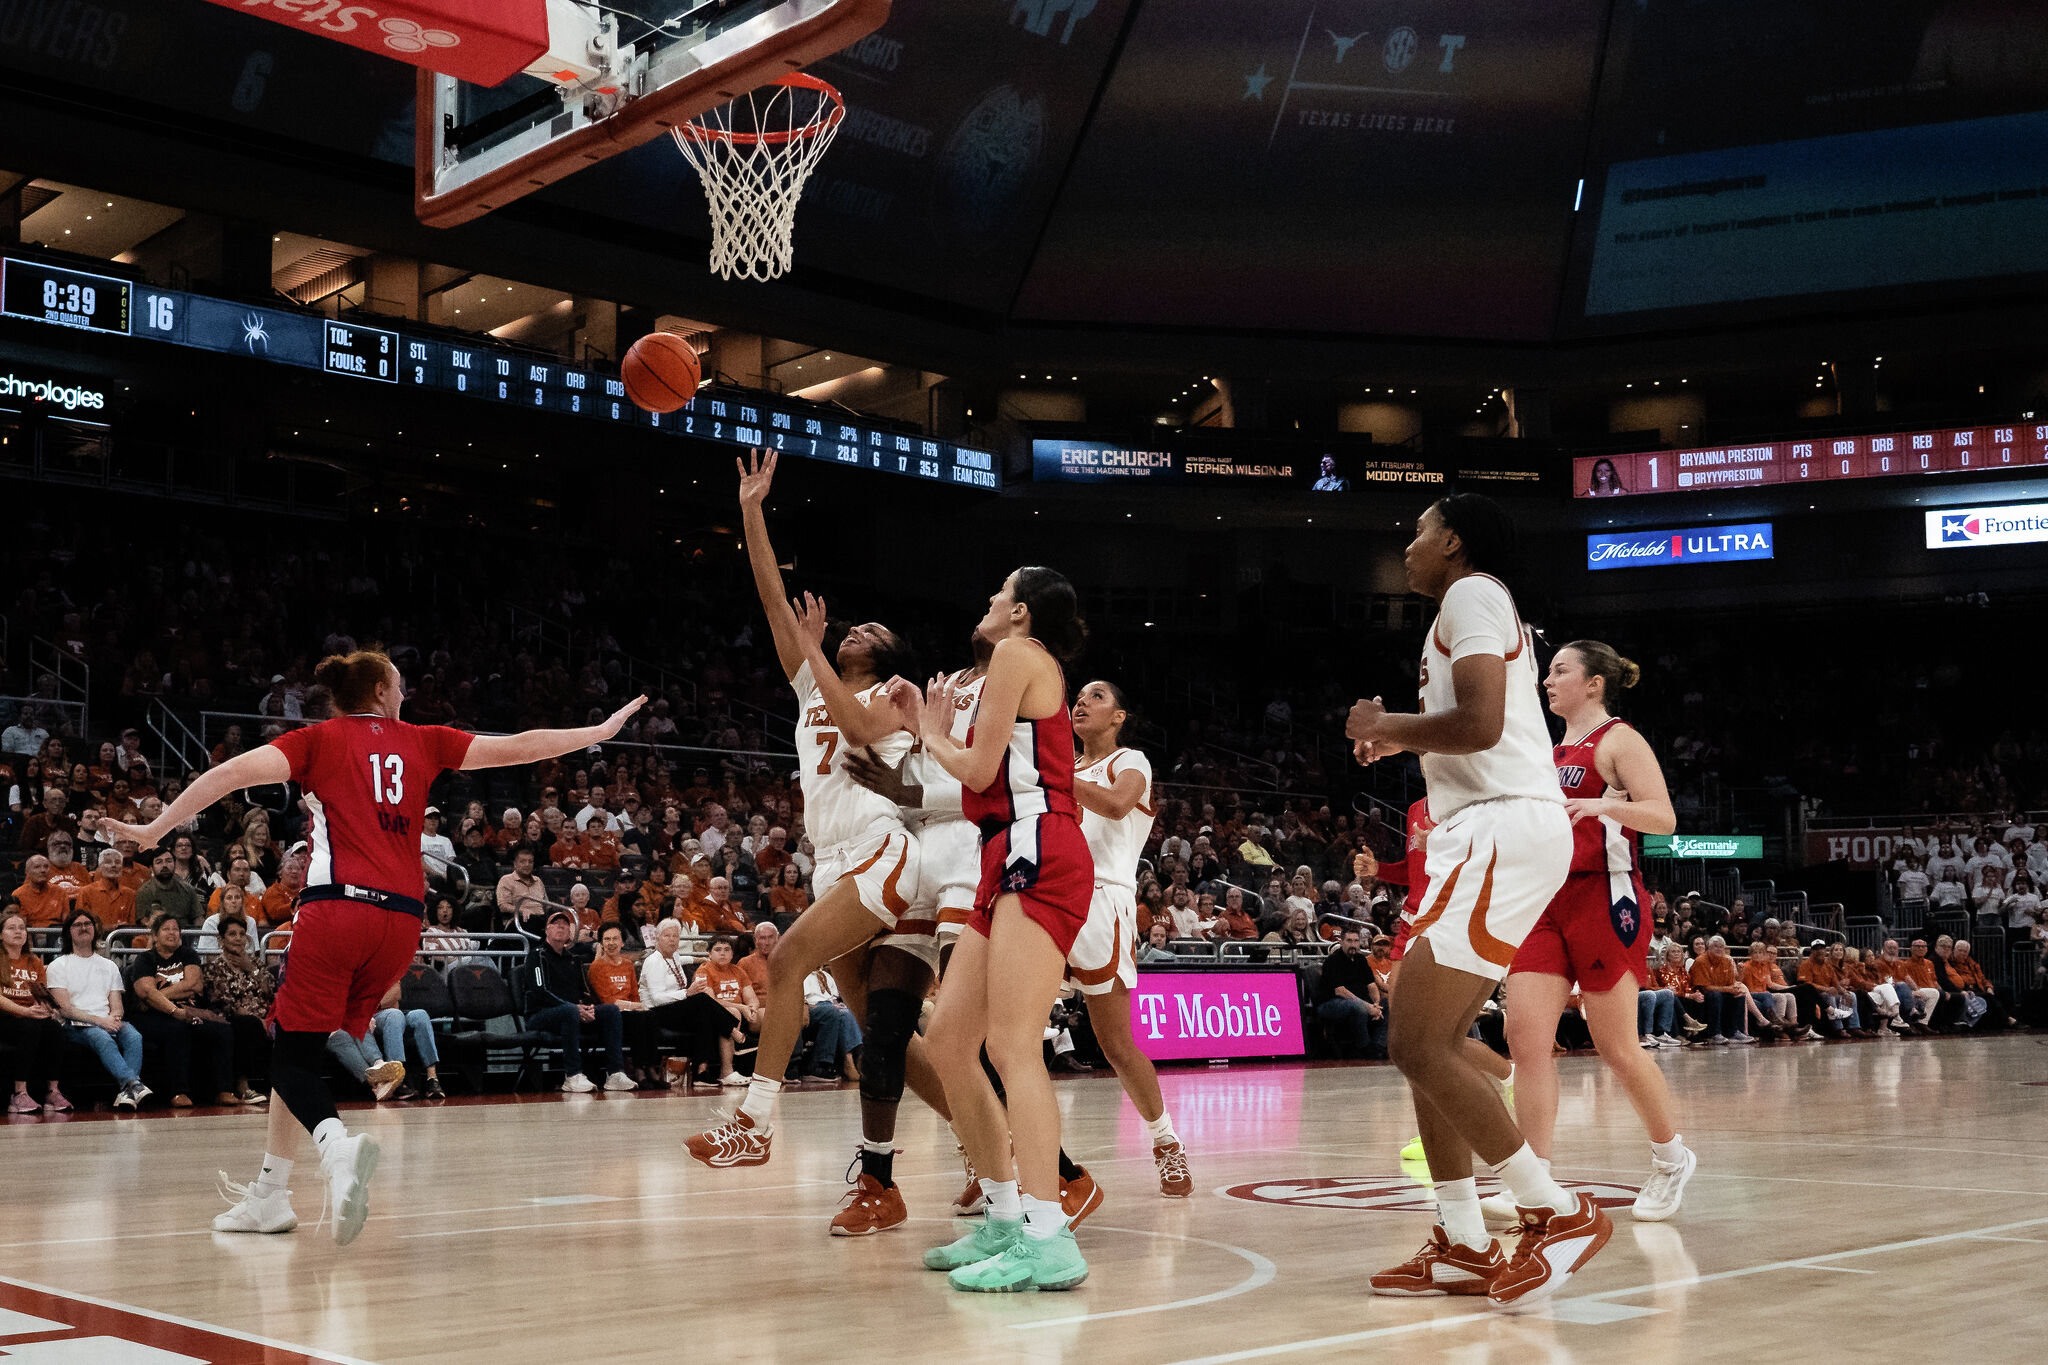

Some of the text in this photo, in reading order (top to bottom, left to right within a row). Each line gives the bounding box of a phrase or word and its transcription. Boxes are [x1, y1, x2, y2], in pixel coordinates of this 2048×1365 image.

[1299, 110, 1455, 134] TEXAS LIVES HERE
[43, 278, 96, 315] 8:39
[45, 309, 90, 326] 2ND QUARTER
[147, 295, 173, 331] 16
[330, 327, 388, 353] TOL: 3
[329, 351, 388, 377] FOULS: 0
[410, 342, 427, 361] STL
[452, 351, 471, 369] BLK
[497, 359, 509, 376] TO
[530, 365, 548, 383] AST
[566, 372, 585, 390] ORB
[606, 379, 624, 397] DRB
[712, 401, 726, 418] FTA
[741, 406, 758, 423] FT%
[772, 413, 790, 430] 3PM
[806, 419, 822, 436] 3PA
[840, 425, 858, 442] 3P%
[871, 431, 881, 447] FG
[896, 436, 910, 452] FGA
[922, 441, 938, 458] FG%
[415, 366, 424, 384] 3
[457, 374, 466, 392] 0
[499, 382, 507, 399] 6
[535, 388, 543, 405] 3
[572, 395, 580, 412] 3
[611, 402, 620, 419] 6
[686, 417, 693, 433] 2
[714, 422, 721, 438] 2
[736, 426, 762, 446] 100.0
[777, 434, 784, 450] 2
[811, 440, 817, 455] 7
[838, 444, 858, 463] 28.6
[873, 451, 880, 467] 6
[899, 456, 907, 472] 17
[920, 460, 939, 478] 35.3
[1793, 444, 1812, 458] PTS
[1833, 440, 1854, 455] ORB
[1872, 438, 1893, 453] DRB
[1913, 434, 1932, 450] REB
[1953, 431, 1974, 447] AST
[1994, 428, 2013, 443] FLS
[957, 447, 992, 471] RICHMOND
[1061, 448, 1172, 468] ERIC CHURCH
[1365, 461, 1379, 470] SAT.
[1381, 461, 1415, 471] FEBRUARY
[1680, 446, 1772, 467] BRYANNA PRESTON
[1800, 463, 1808, 478] 3
[1841, 460, 1849, 475] 0
[1881, 457, 1889, 472] 0
[1921, 454, 1929, 468] 0
[1961, 451, 1969, 466] 0
[2002, 447, 2010, 463] 0
[953, 465, 996, 487] TEAM STATS
[1061, 466, 1151, 477] FREE THE MACHINE TOUR
[1185, 462, 1292, 477] STEPHEN WILSON JR
[1366, 470, 1403, 483] MOODY
[1405, 471, 1444, 484] CENTER
[1648, 457, 1658, 488] 1
[1694, 467, 1763, 485] BRYYYPRESTON
[1985, 515, 2048, 533] Frontie
[1590, 533, 1769, 562] Michelob ULTRA
[816, 731, 838, 775] 7
[369, 753, 404, 805] 13
[1689, 839, 1738, 850] Germania
[1138, 992, 1282, 1039] T Mobile
